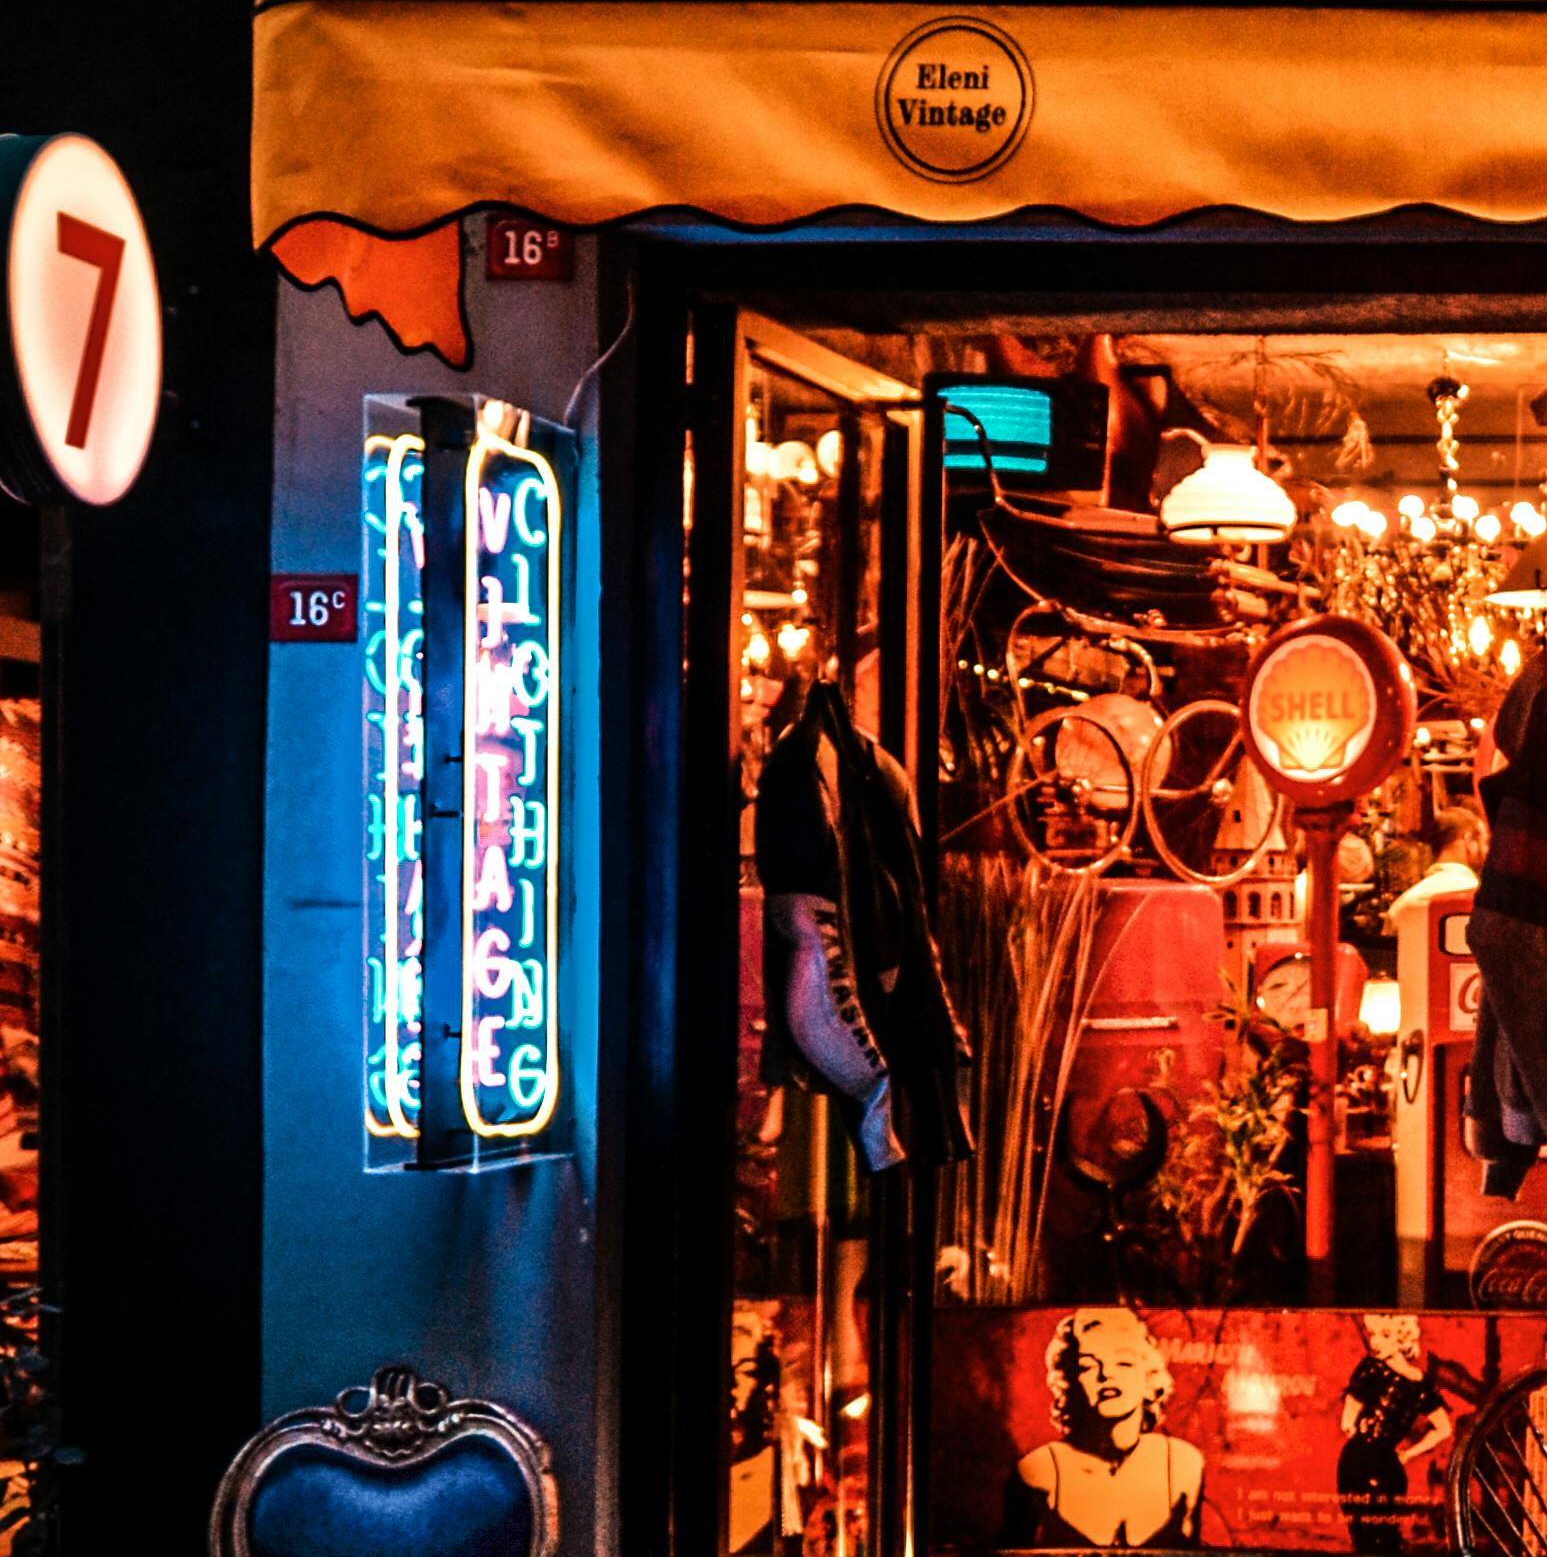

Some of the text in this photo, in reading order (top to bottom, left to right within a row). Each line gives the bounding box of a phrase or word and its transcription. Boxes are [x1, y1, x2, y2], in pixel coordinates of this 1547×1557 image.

[916, 63, 990, 90] Eleni
[897, 98, 1007, 134] Vintage
[57, 210, 126, 450] 7
[1270, 689, 1357, 723] SHELL
[506, 476, 549, 1108] CLOTHING
